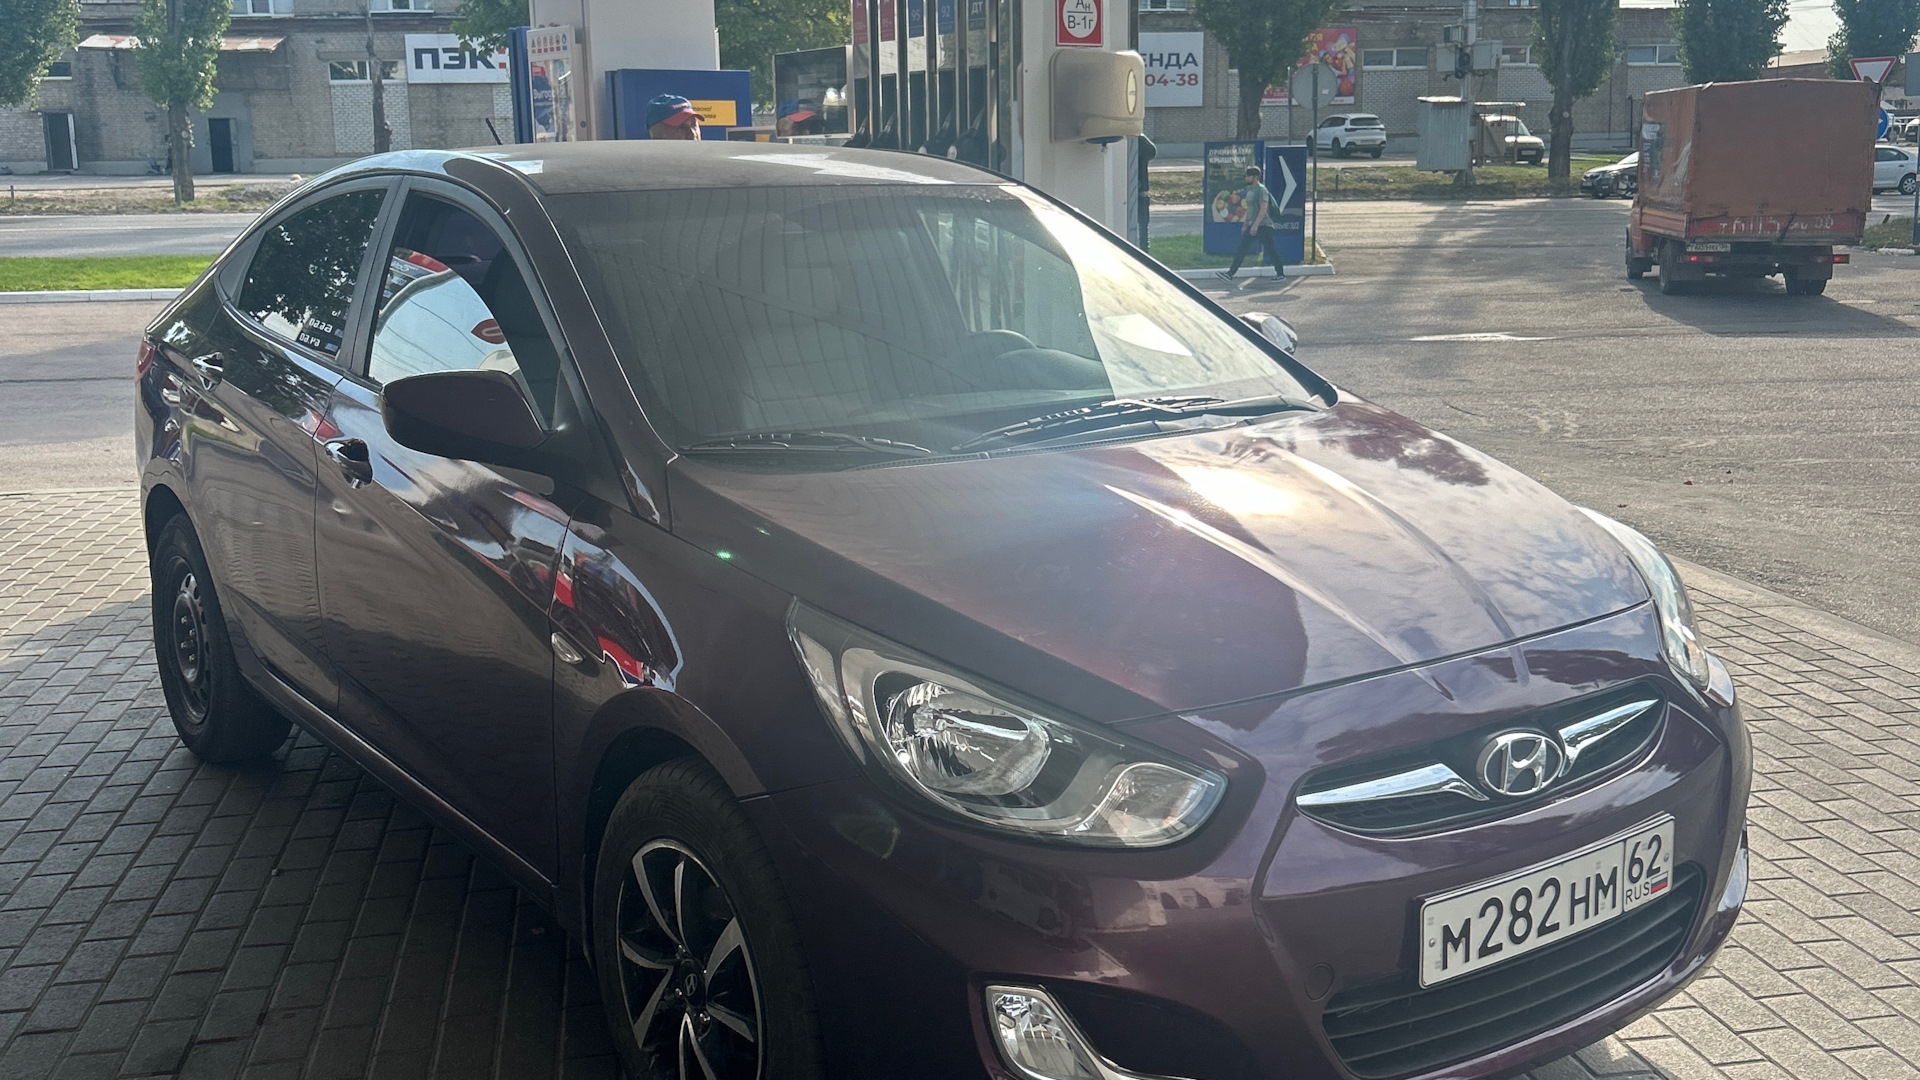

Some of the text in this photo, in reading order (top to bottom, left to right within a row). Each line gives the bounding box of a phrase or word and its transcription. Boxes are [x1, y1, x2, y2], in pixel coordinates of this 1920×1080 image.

[941, 5, 951, 18] 92
[971, 1, 984, 15] ДТ
[911, 9, 920, 22] 95
[1625, 881, 1650, 905] RUS
[1441, 834, 1662, 971] М282НМ 62
